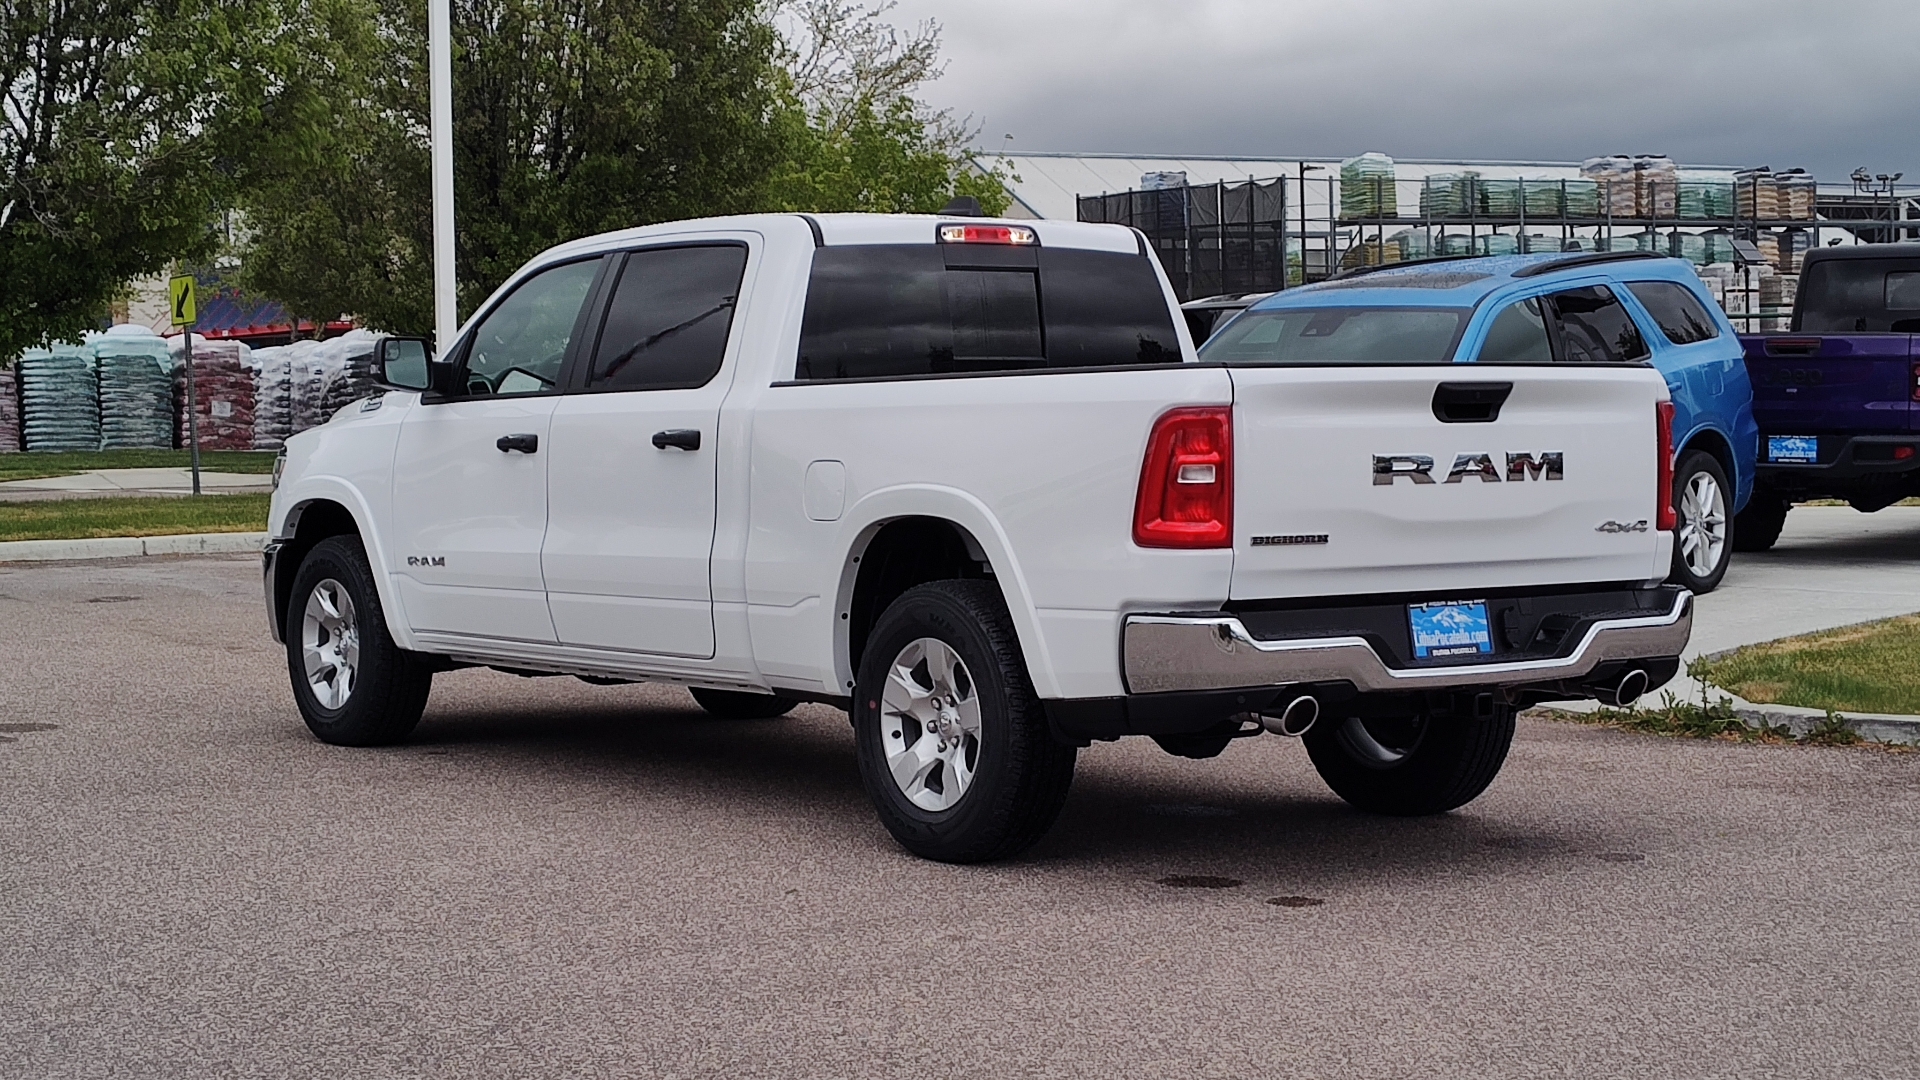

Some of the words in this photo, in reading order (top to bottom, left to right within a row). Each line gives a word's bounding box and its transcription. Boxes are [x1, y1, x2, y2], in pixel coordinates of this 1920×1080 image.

[1372, 450, 1564, 486] RAM
[1250, 534, 1329, 546] BIGHORN
[407, 556, 446, 567] RAM
